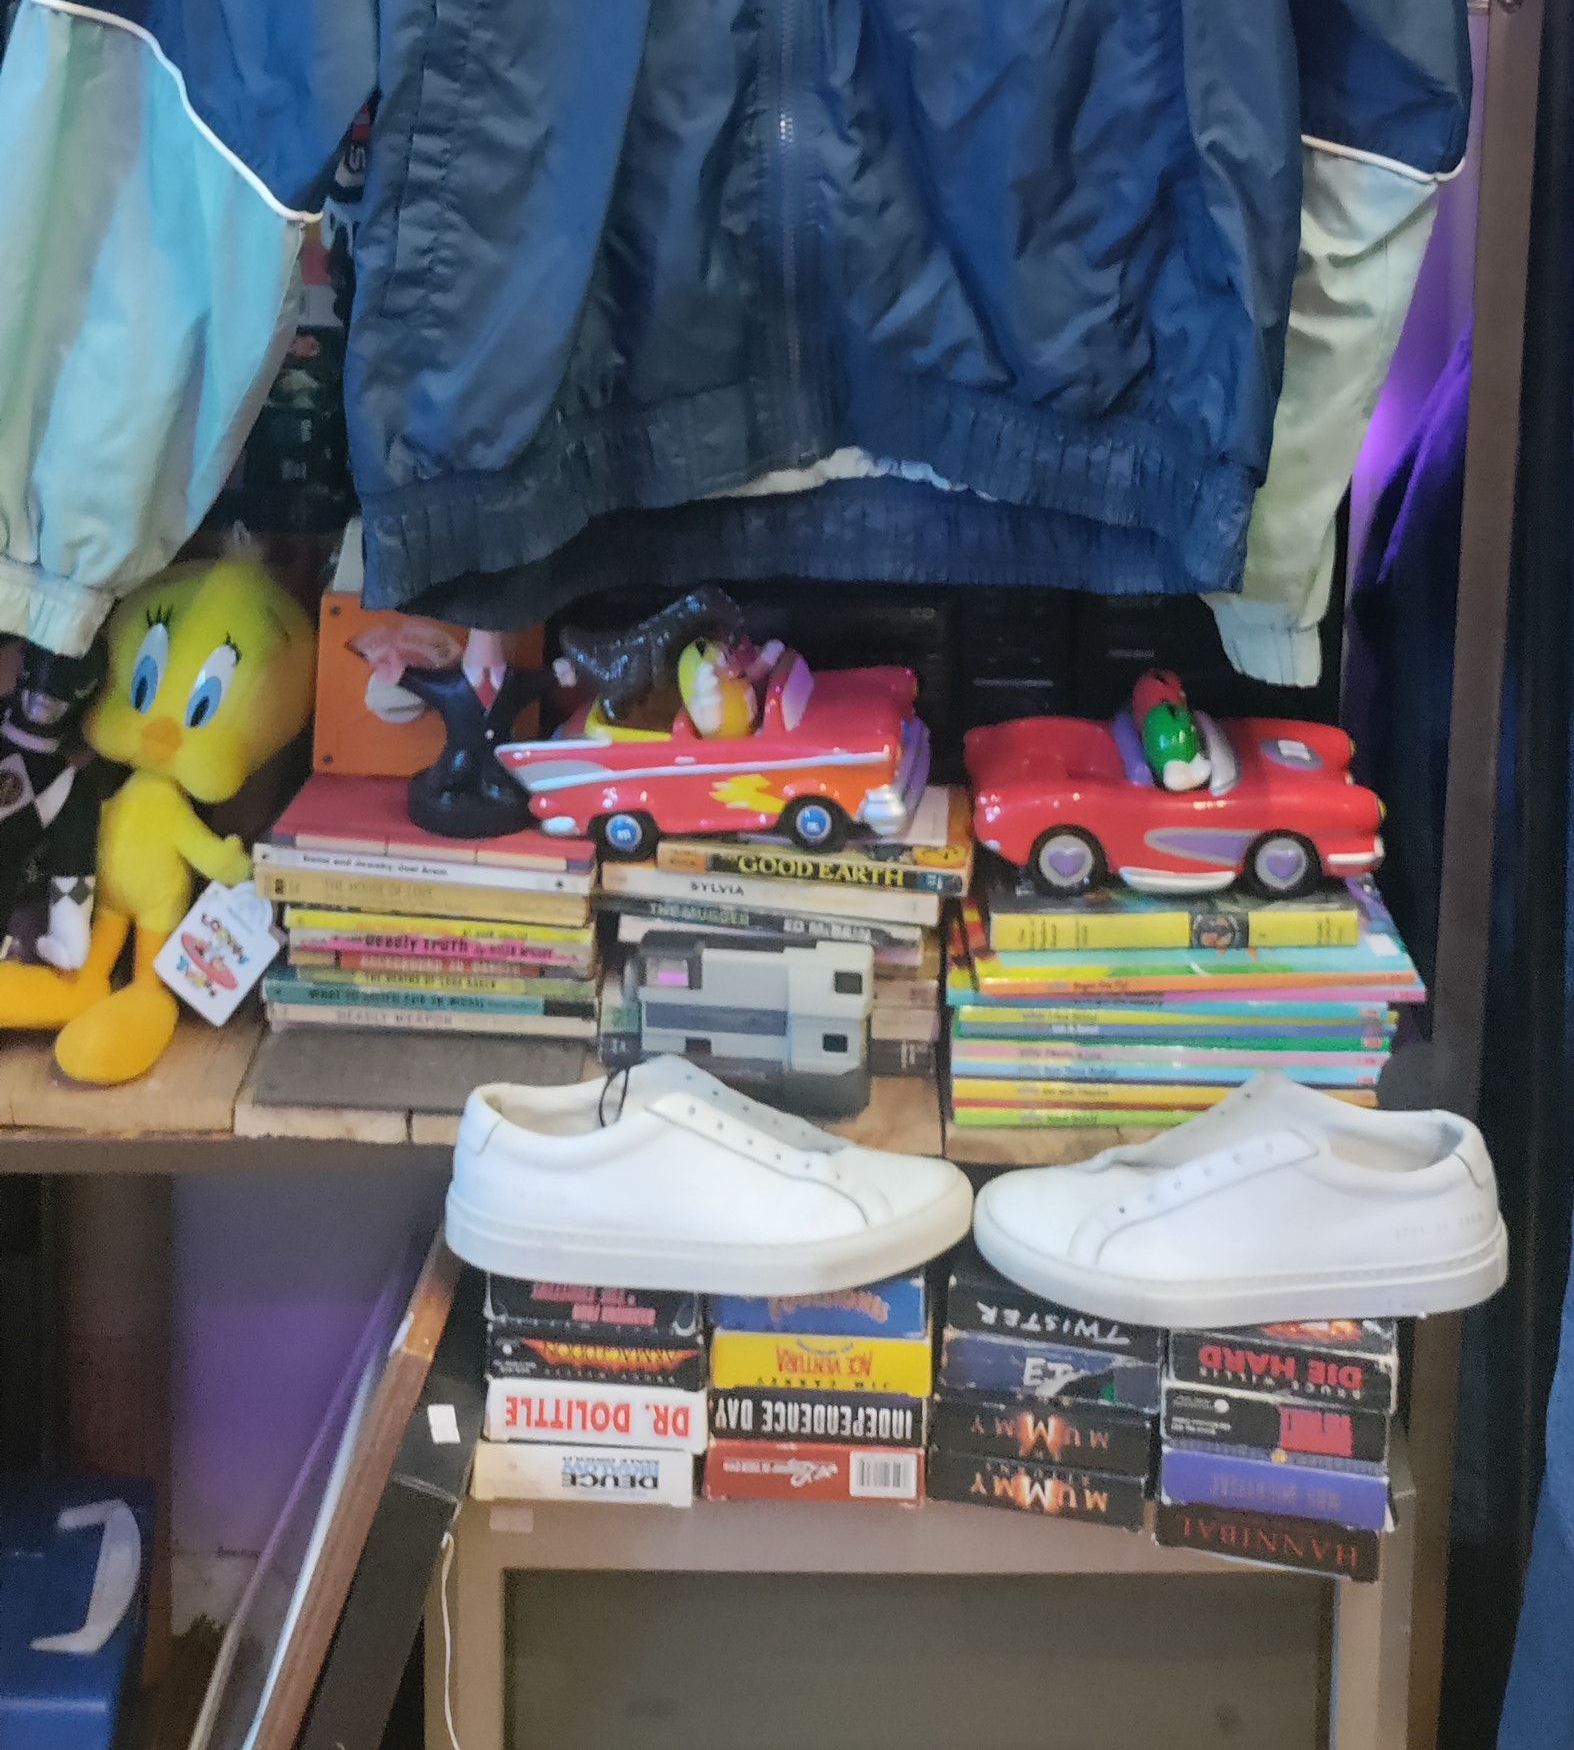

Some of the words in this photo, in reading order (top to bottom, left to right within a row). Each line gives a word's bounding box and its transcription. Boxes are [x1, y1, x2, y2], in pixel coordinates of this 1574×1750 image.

[738, 853, 818, 880] GOOD
[819, 859, 905, 887] EARTH
[690, 880, 744, 897] SYLVIA
[366, 934, 419, 952] Deadly
[422, 937, 469, 953] Truth
[976, 1300, 1130, 1346] TWISTER
[1198, 1345, 1297, 1380] HARD
[1307, 1359, 1364, 1391] DIE
[505, 1394, 631, 1434] DOLITTLE
[642, 1401, 690, 1438] DR.
[715, 1398, 754, 1430] DAY
[762, 1399, 913, 1439] INDEPENDENCE
[970, 1410, 1111, 1458] MUMMY
[561, 1471, 660, 1490] DEUCE
[970, 1471, 1110, 1513] MUMMY
[1182, 1516, 1359, 1569] HANNIBAL
